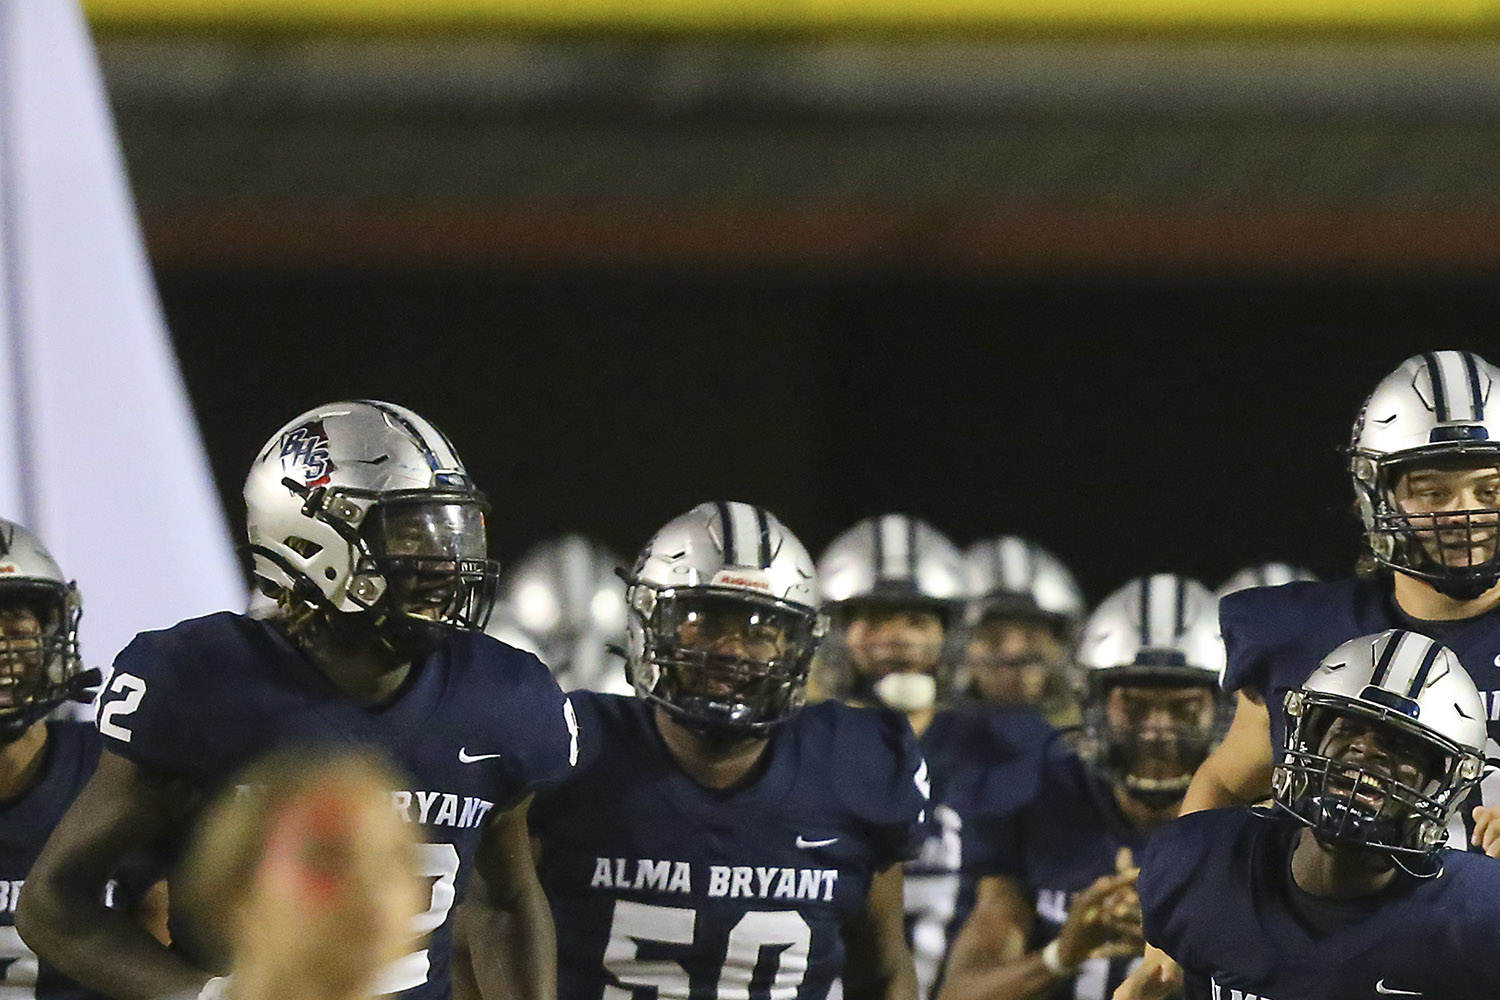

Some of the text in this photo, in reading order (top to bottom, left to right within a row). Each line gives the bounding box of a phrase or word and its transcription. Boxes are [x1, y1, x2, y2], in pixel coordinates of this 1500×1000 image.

[96, 667, 147, 742] 2
[392, 791, 494, 829] RYANT
[591, 857, 839, 900] ALMA BRYANT
